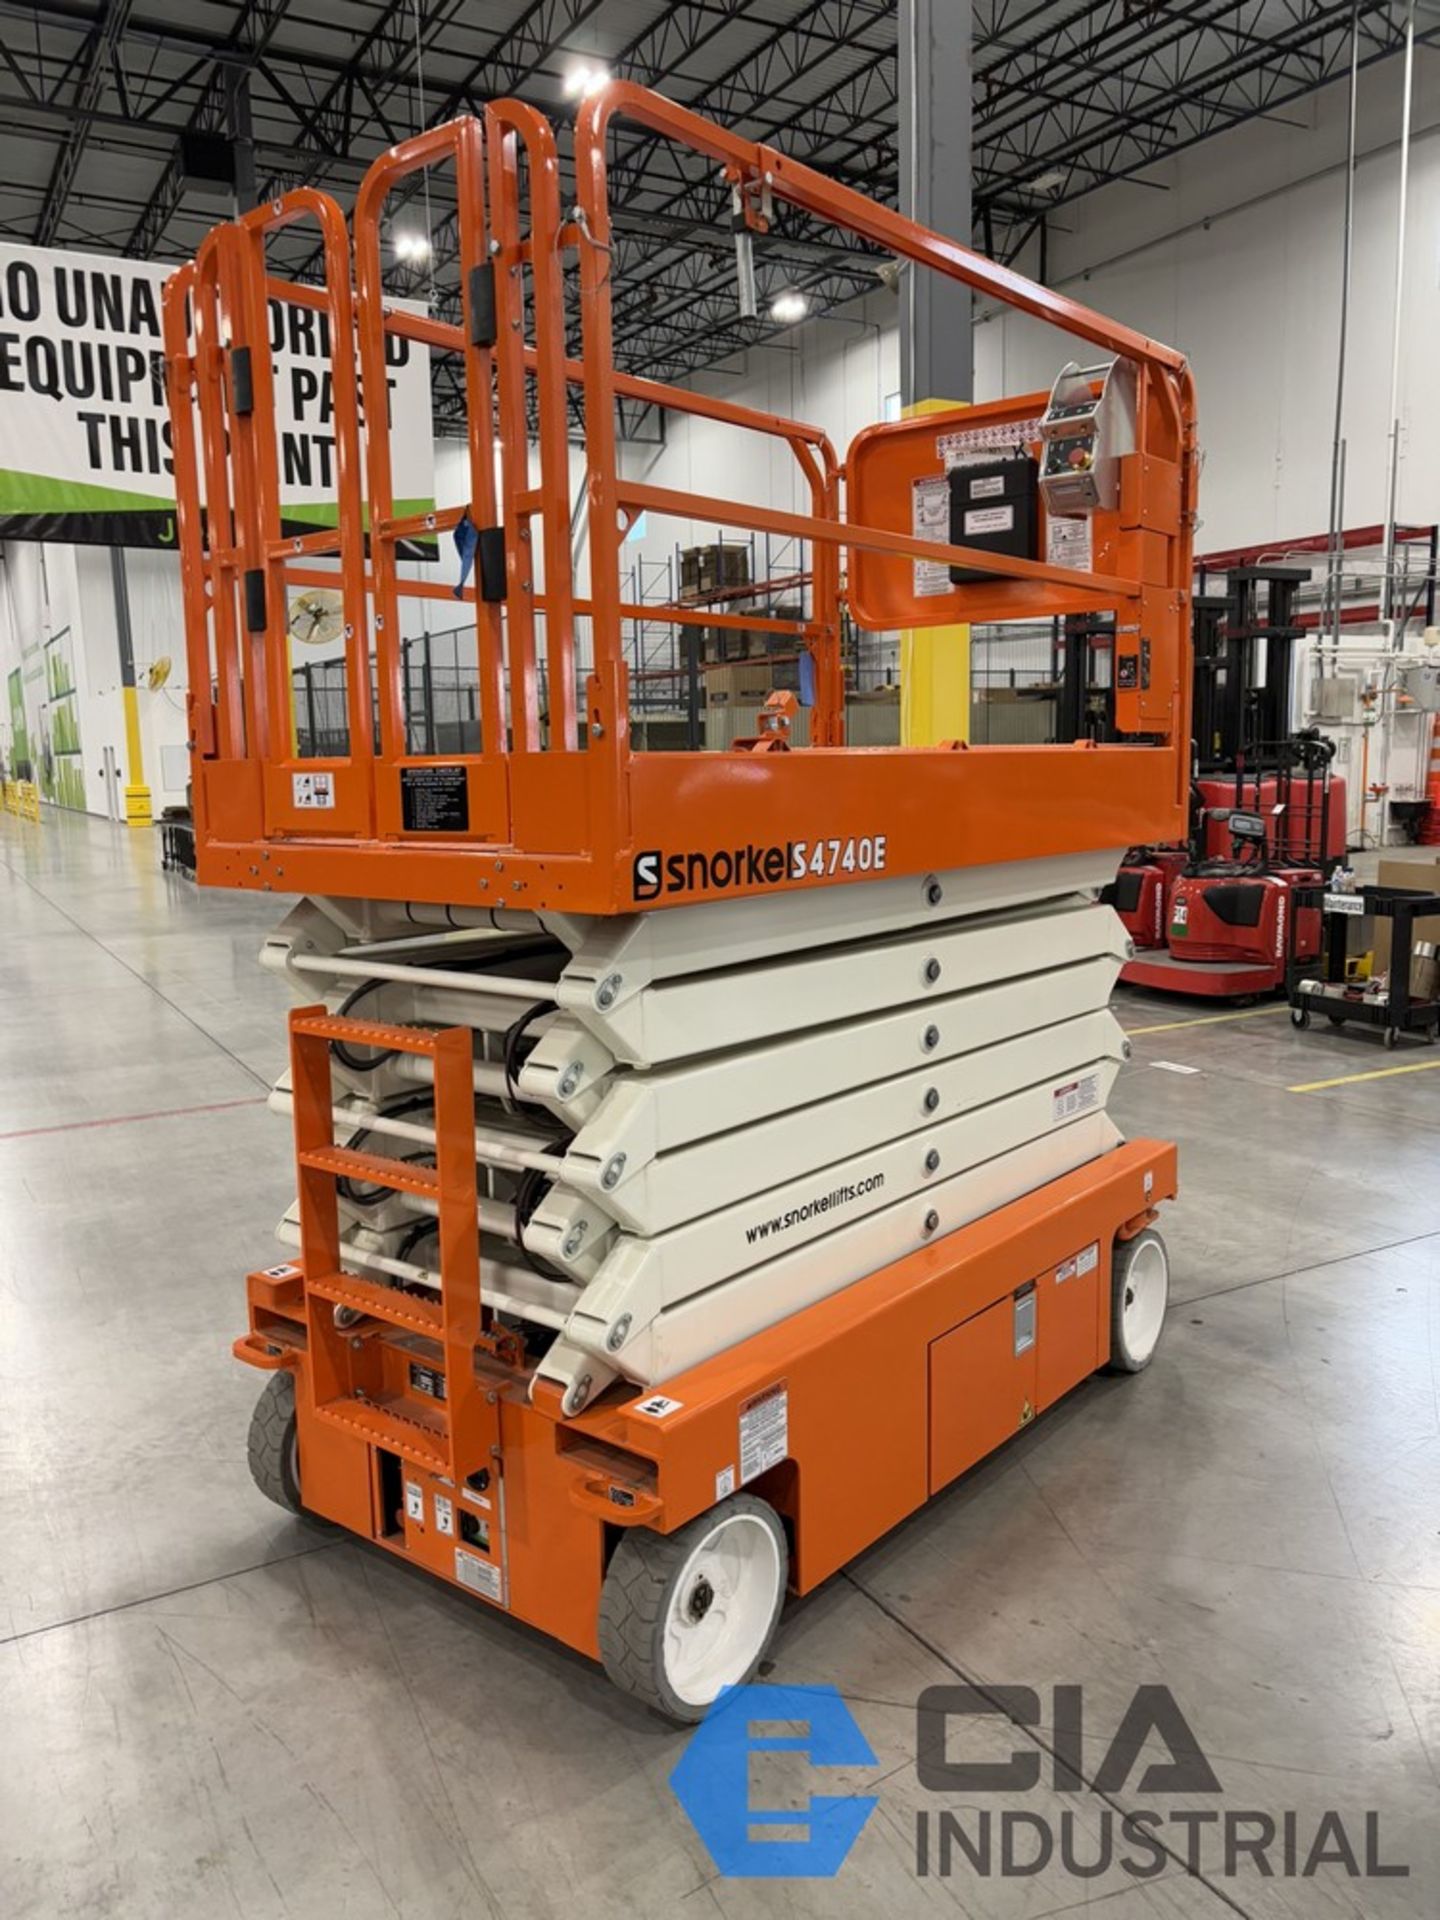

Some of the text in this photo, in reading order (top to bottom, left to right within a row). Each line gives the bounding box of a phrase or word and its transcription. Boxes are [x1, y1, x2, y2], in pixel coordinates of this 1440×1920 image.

[0, 261, 41, 322] O
[666, 835, 886, 892] snorkel S4740E
[745, 1172, 885, 1245] www.snorkellifts.com
